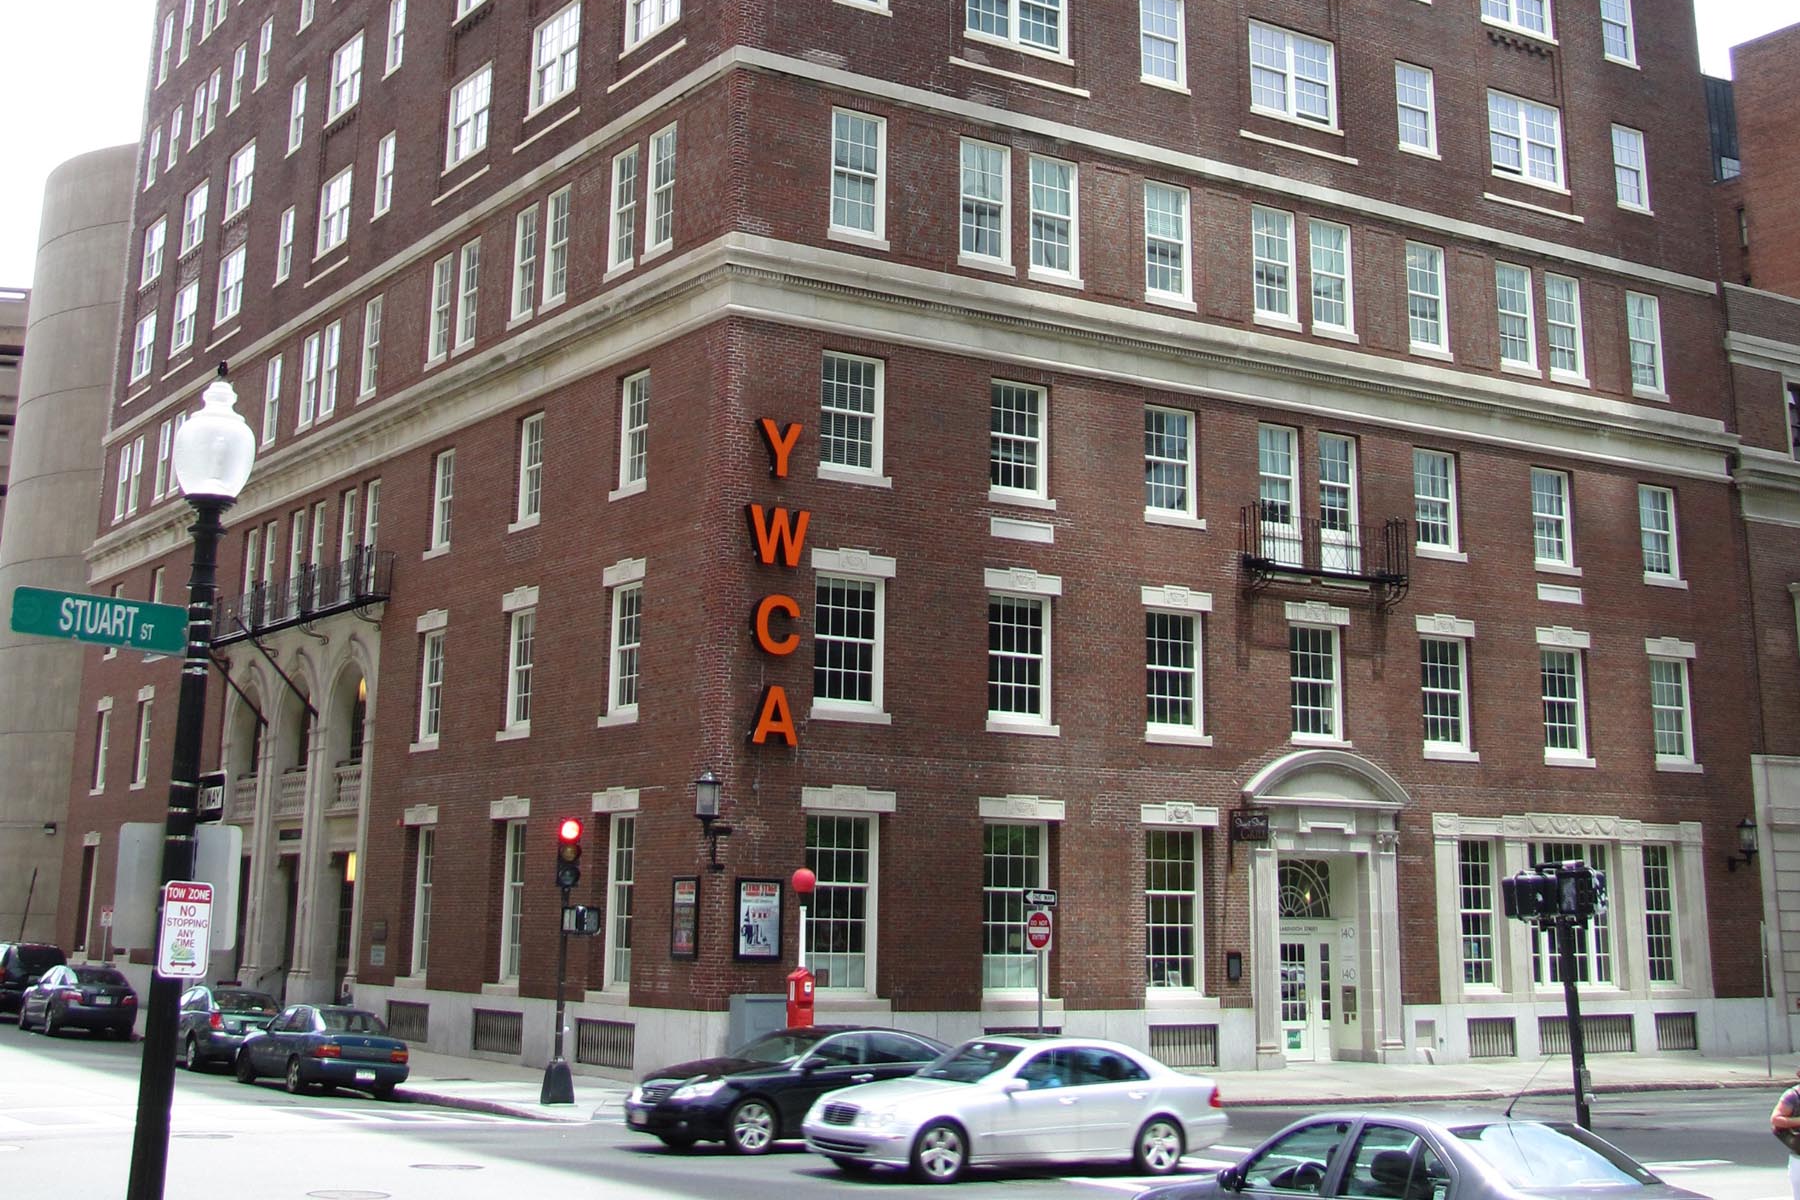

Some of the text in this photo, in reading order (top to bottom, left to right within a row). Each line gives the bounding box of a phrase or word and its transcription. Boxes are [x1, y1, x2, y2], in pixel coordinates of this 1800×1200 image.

[749, 416, 811, 747] YWCA
[59, 597, 155, 641] STUART ST
[168, 887, 211, 901] TOW ZONE
[180, 905, 196, 918] NO
[166, 917, 208, 929] STOPPING
[177, 929, 195, 939] ANY
[176, 938, 196, 949] TIME
[1342, 967, 1356, 980] 140
